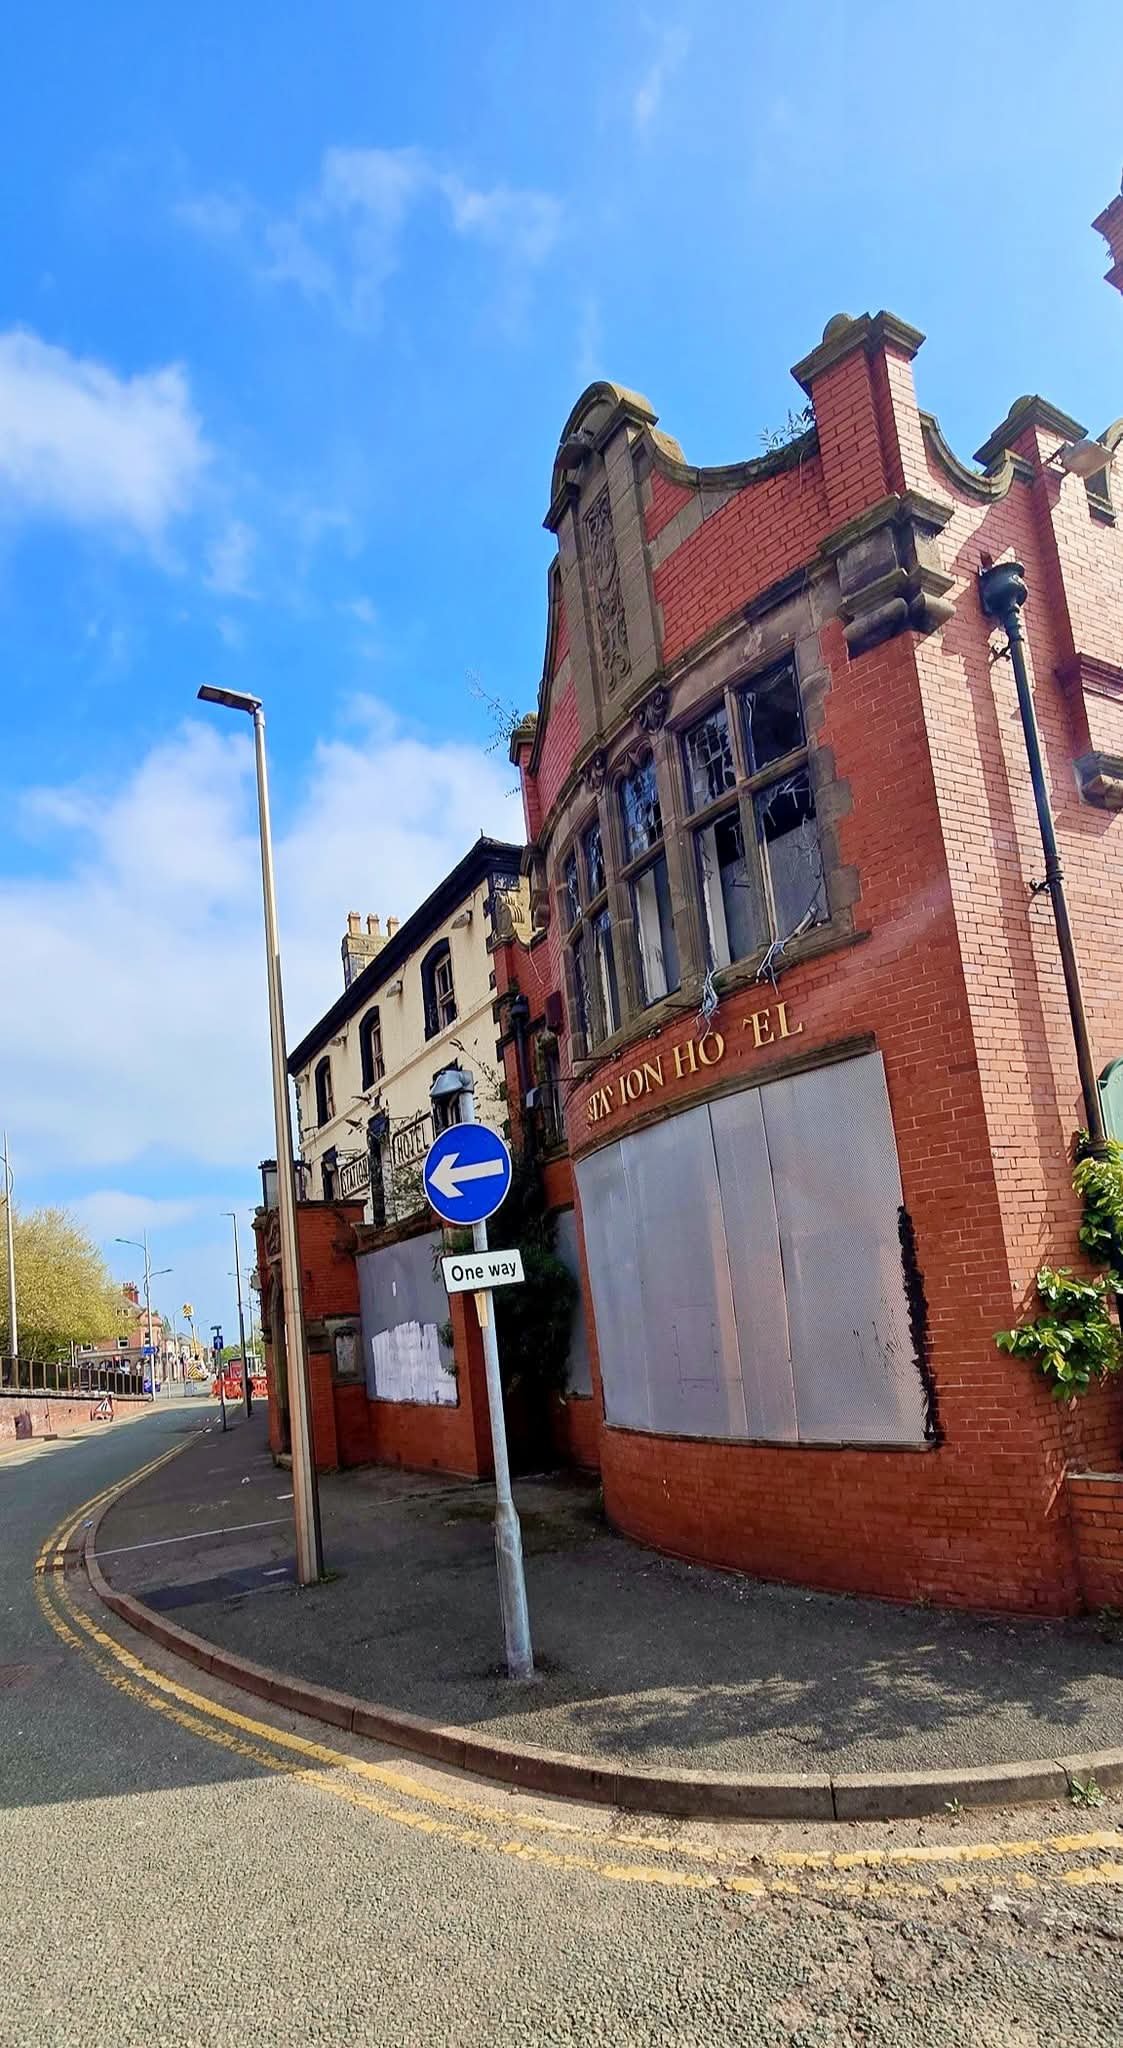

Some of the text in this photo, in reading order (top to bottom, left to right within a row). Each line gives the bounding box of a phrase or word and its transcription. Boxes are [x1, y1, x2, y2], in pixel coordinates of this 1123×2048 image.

[585, 1001, 803, 1129] STAION HOEL
[397, 1122, 430, 1163] HOTEL
[451, 1262, 516, 1281] One way
